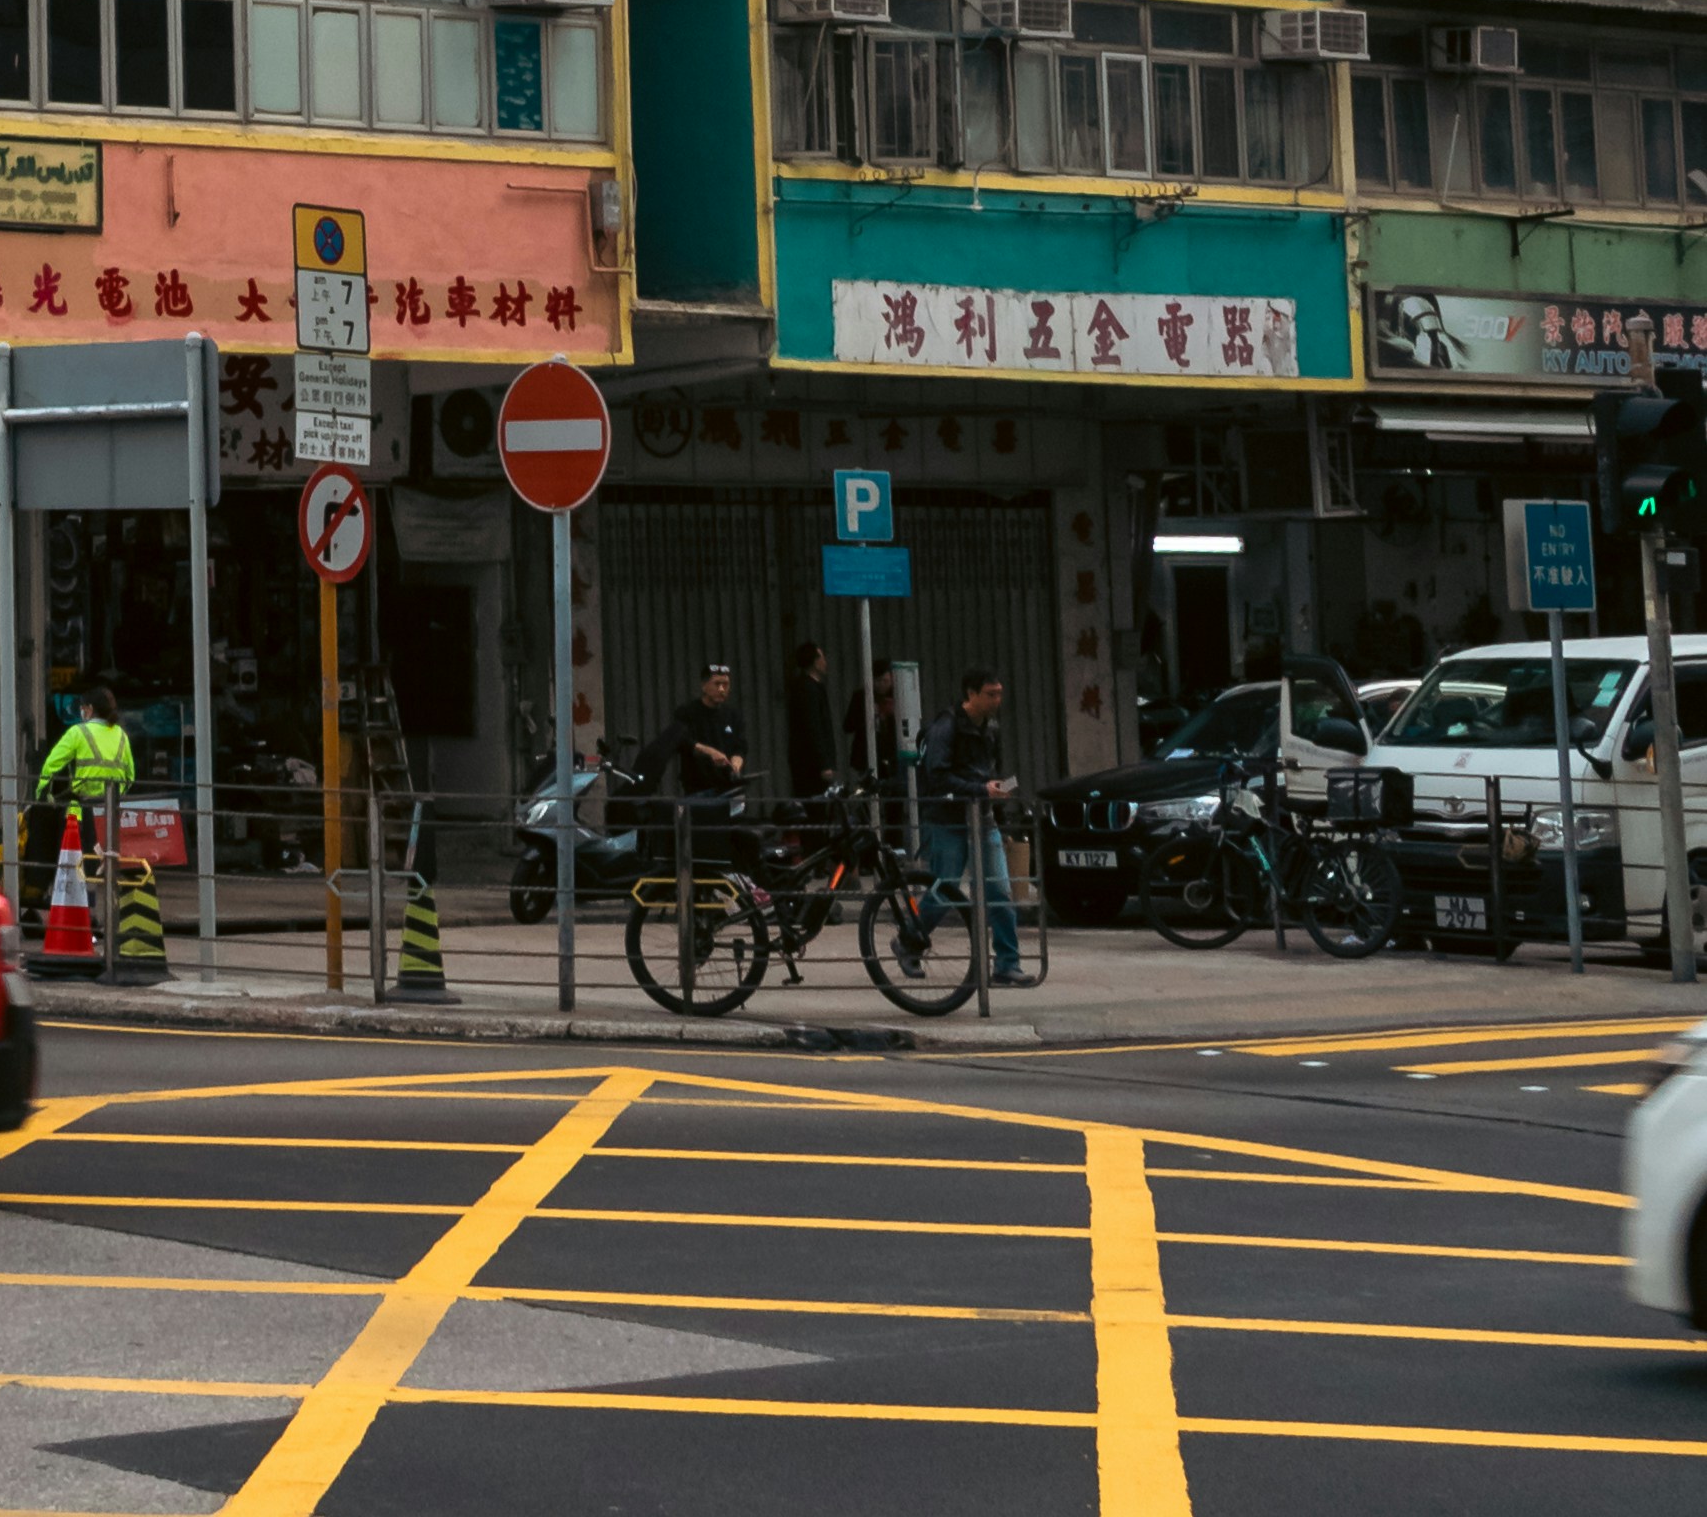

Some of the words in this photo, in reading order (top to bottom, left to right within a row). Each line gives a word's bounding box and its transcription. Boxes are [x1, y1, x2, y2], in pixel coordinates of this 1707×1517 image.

[311, 287, 330, 302] 上午
[341, 280, 353, 304] 7
[236, 275, 582, 333] 大汽車材料
[313, 328, 331, 342] 下午
[315, 316, 328, 325] pm
[343, 320, 354, 345] 7
[881, 289, 1254, 367] 鴻利五金電器
[318, 360, 346, 373] Except
[1542, 348, 1571, 373] KY
[1574, 349, 1632, 375] AUTO
[298, 371, 330, 384] General
[332, 374, 367, 389] Holidays
[313, 416, 338, 429] Except
[339, 421, 355, 430] taxi
[303, 430, 318, 439] pick
[351, 433, 363, 444] off
[845, 478, 880, 533] P
[1549, 524, 1566, 538] NO
[1450, 897, 1470, 913] MA
[1445, 910, 1477, 928] 297
